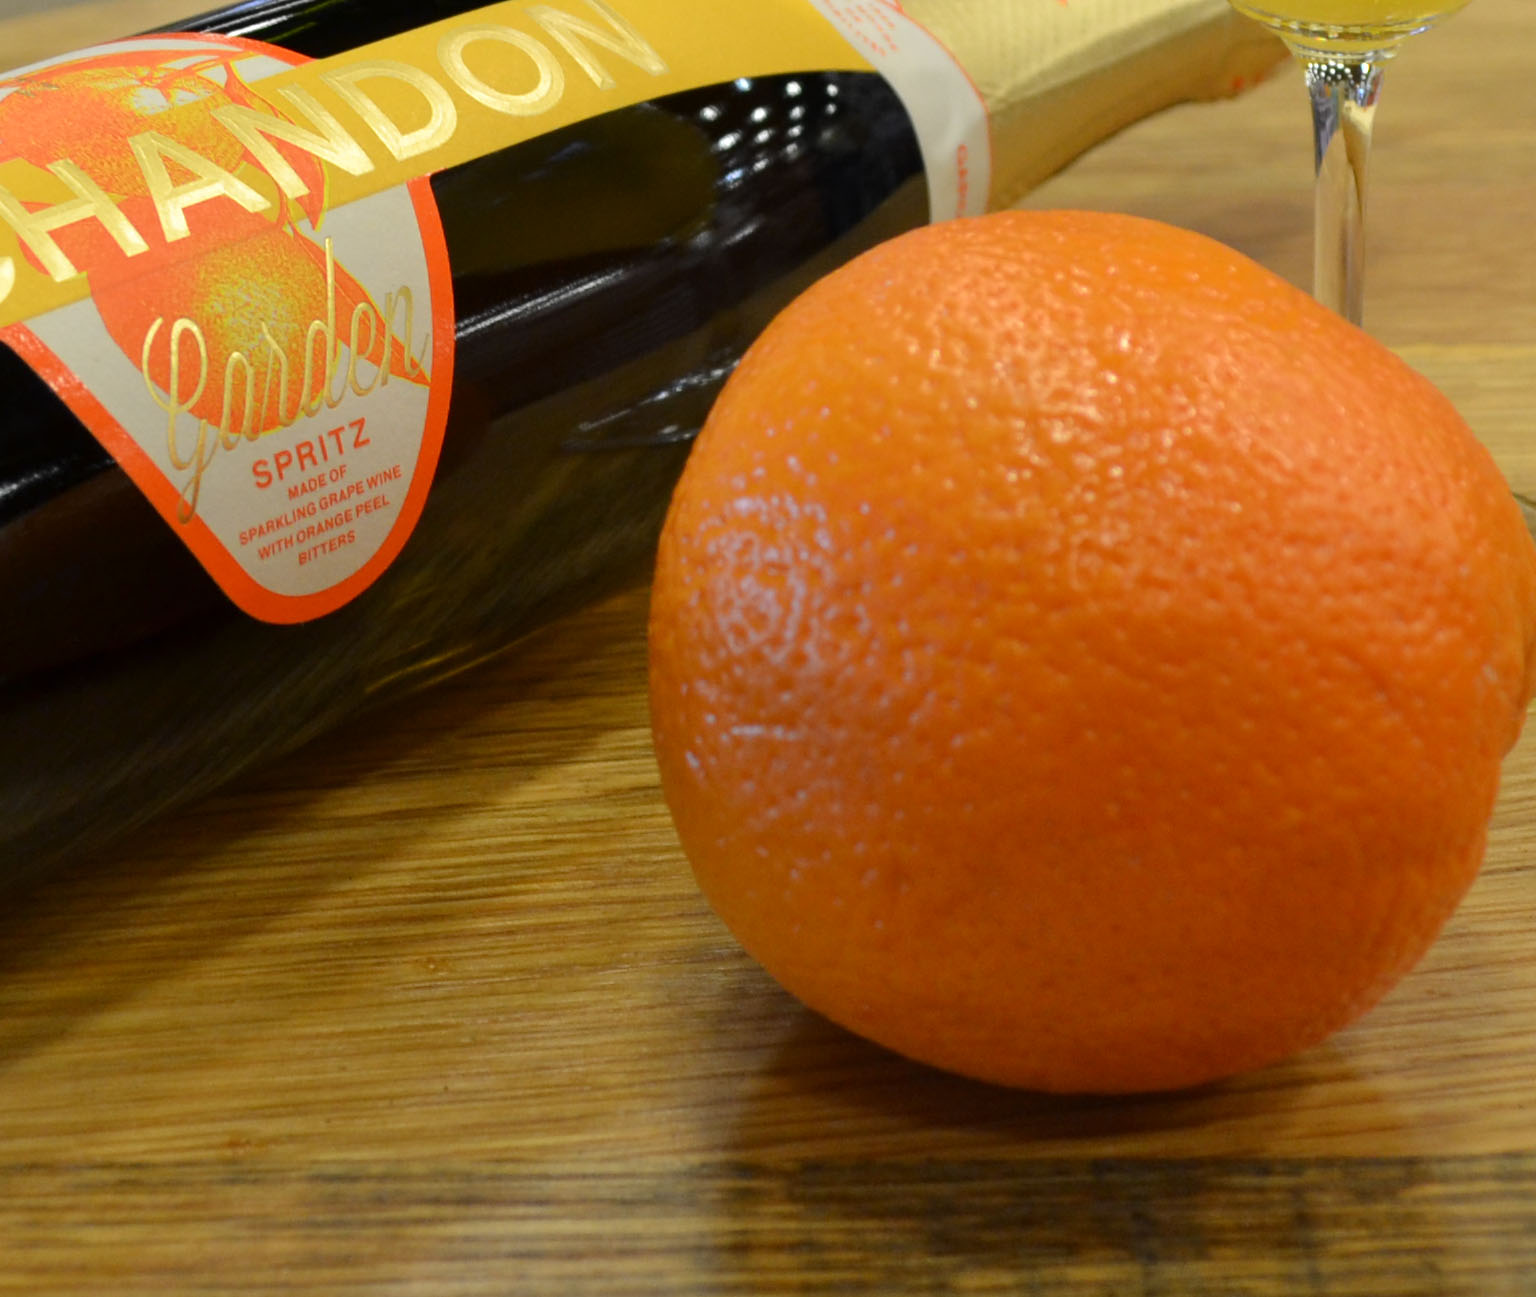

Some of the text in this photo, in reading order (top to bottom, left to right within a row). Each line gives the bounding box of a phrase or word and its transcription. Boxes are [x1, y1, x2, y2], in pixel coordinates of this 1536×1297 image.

[142, 236, 430, 525] Garden
[252, 417, 370, 488] SPRITZ
[287, 464, 348, 500] MADE OF
[239, 464, 403, 545] SPARKLING GRAPE WINE
[258, 493, 390, 561] WITH ORANGE PEEL
[298, 530, 355, 565] BITTERS
